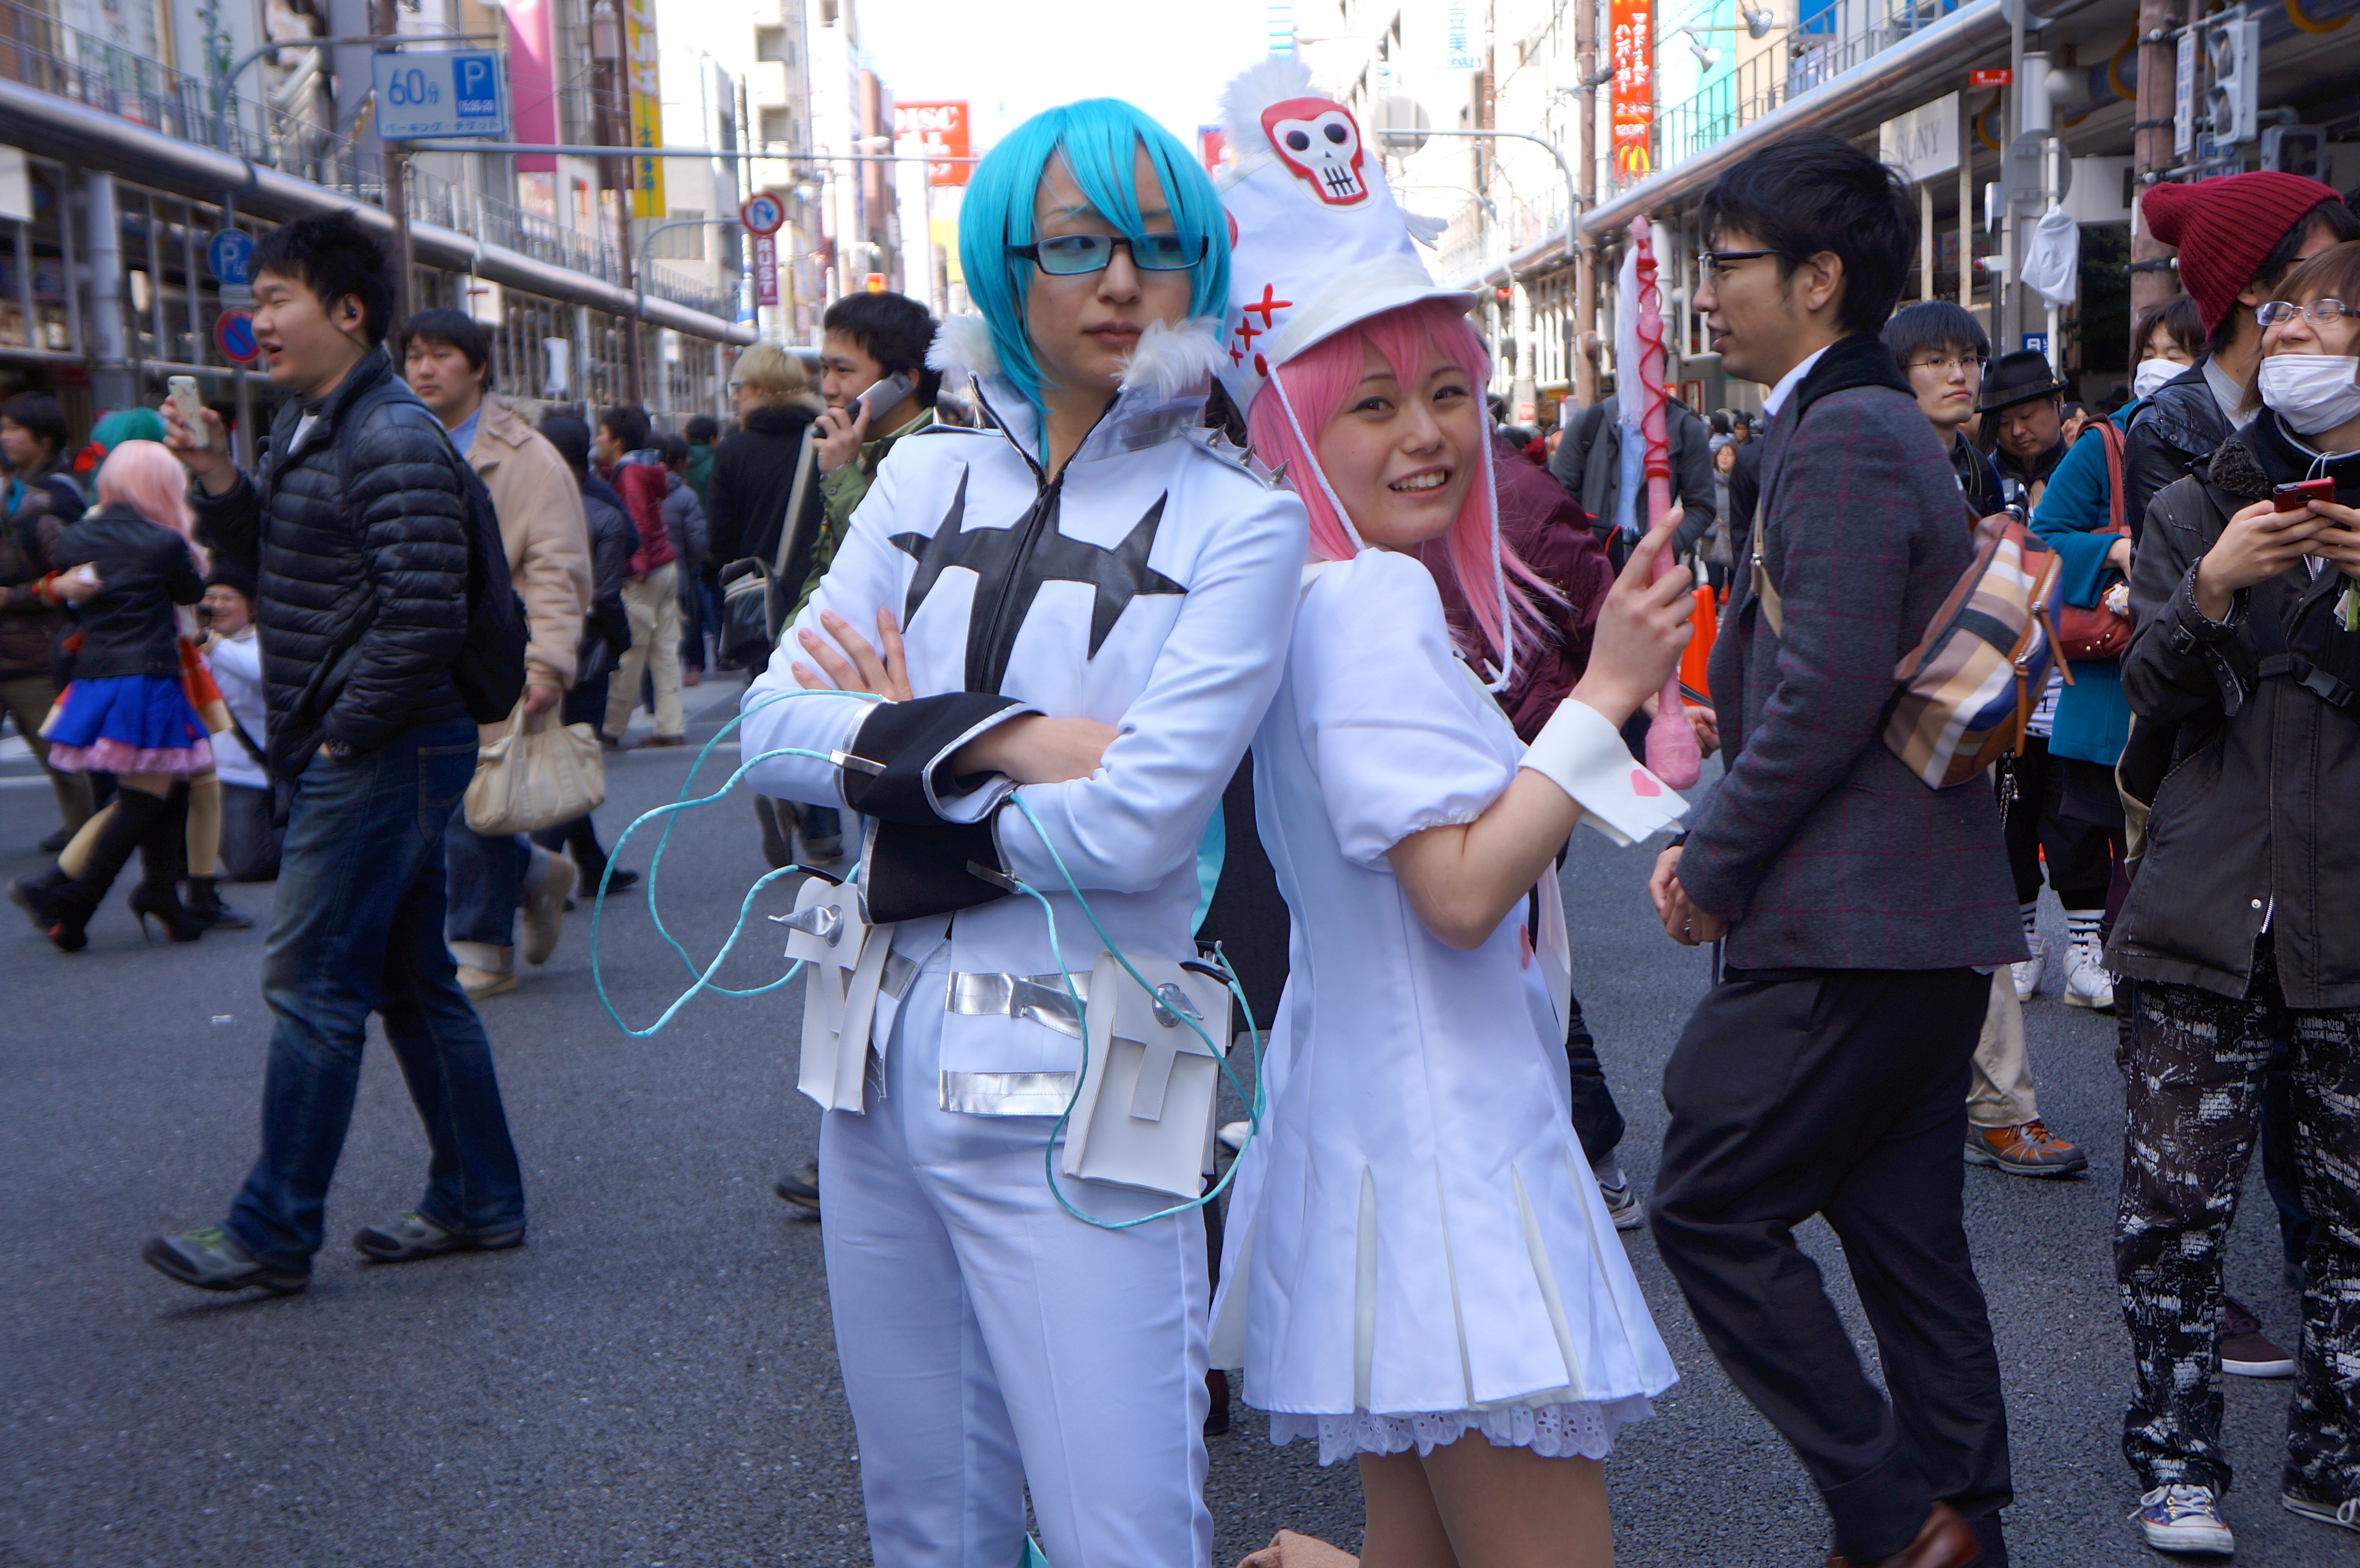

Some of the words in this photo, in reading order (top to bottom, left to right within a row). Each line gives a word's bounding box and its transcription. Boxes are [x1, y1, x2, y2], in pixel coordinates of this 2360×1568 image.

[1614, 24, 1632, 95] ハンバーガー
[1632, 12, 1649, 86] マクドナルド
[464, 60, 487, 96] P
[893, 106, 959, 131] DISC
[219, 241, 239, 277] P
[756, 235, 776, 296] RUST
